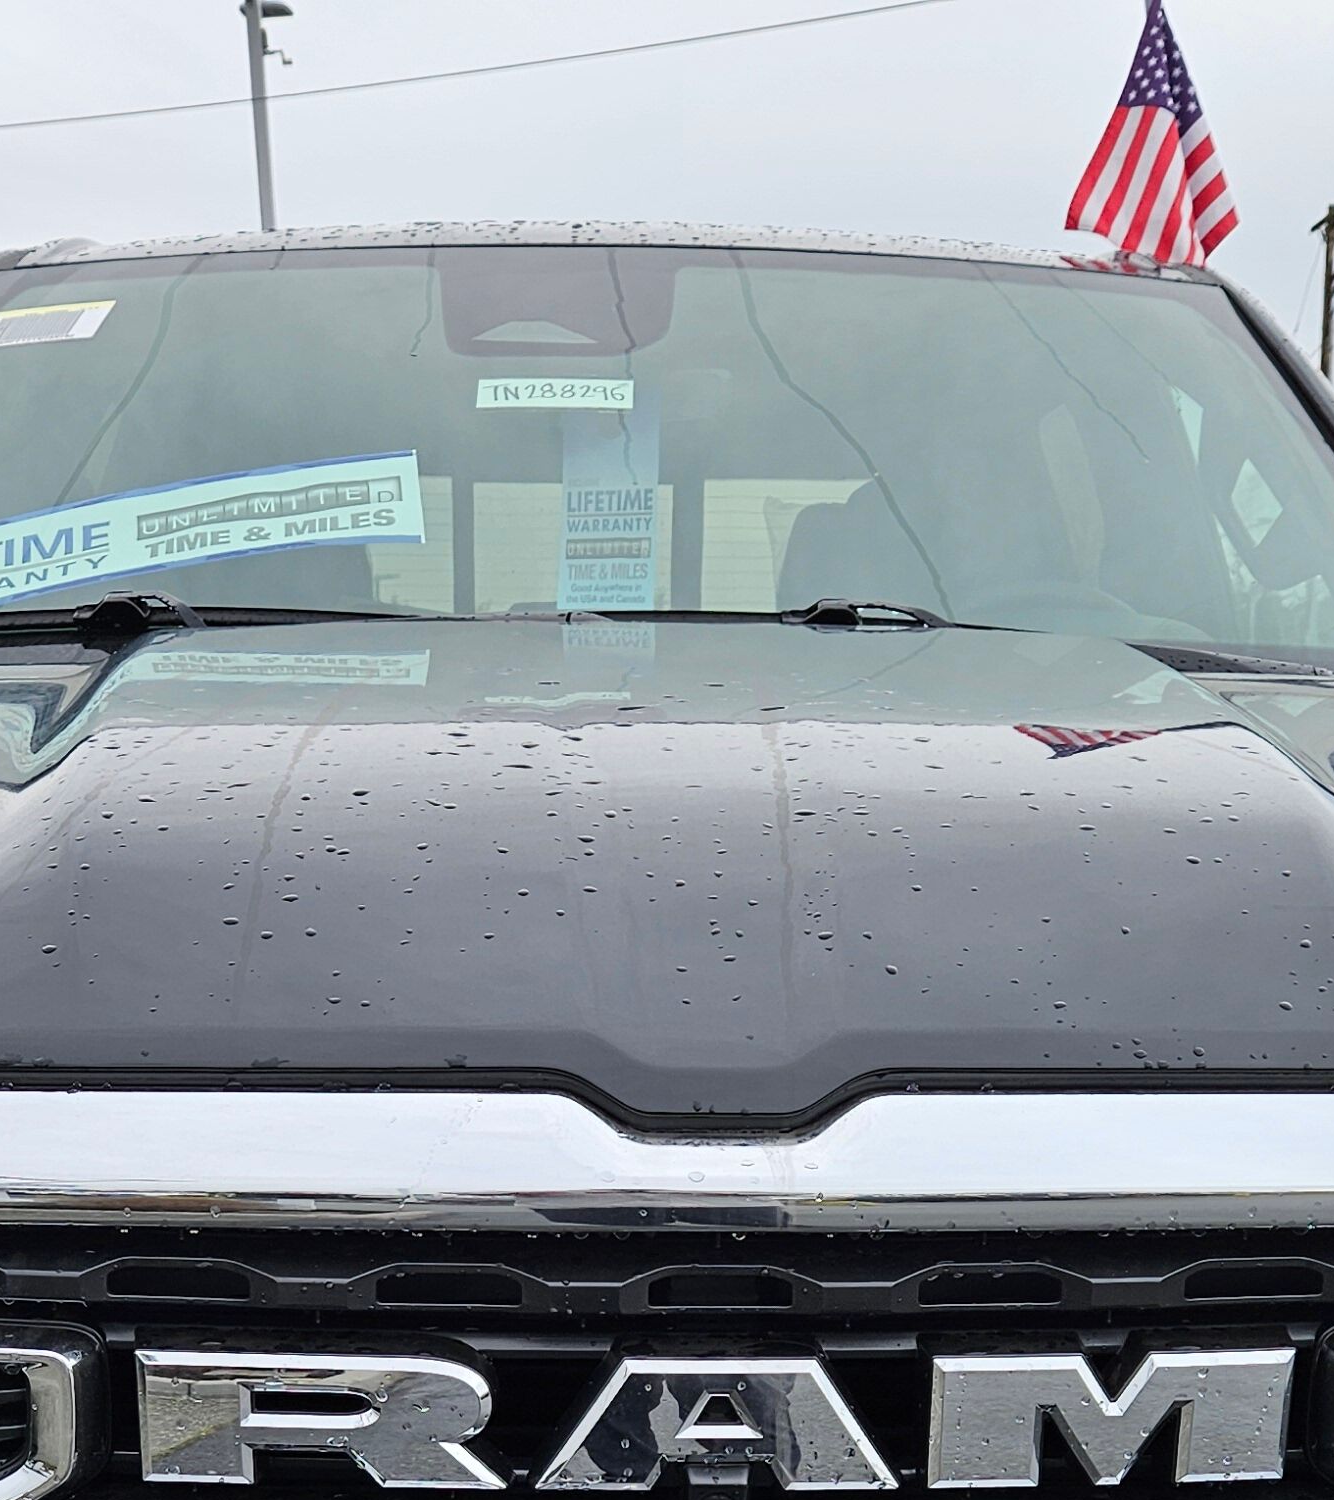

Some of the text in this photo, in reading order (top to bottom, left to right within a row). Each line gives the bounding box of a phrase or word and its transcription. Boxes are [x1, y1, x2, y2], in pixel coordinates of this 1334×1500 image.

[483, 383, 629, 401] TN288296
[142, 484, 395, 535] UNLIMITED
[567, 488, 653, 512] LIFETIME
[145, 508, 396, 559] TIME & MILES
[567, 517, 652, 532] WARRANTY
[568, 562, 648, 580] TIME & MILES
[135, 1346, 1295, 1492] RAM
